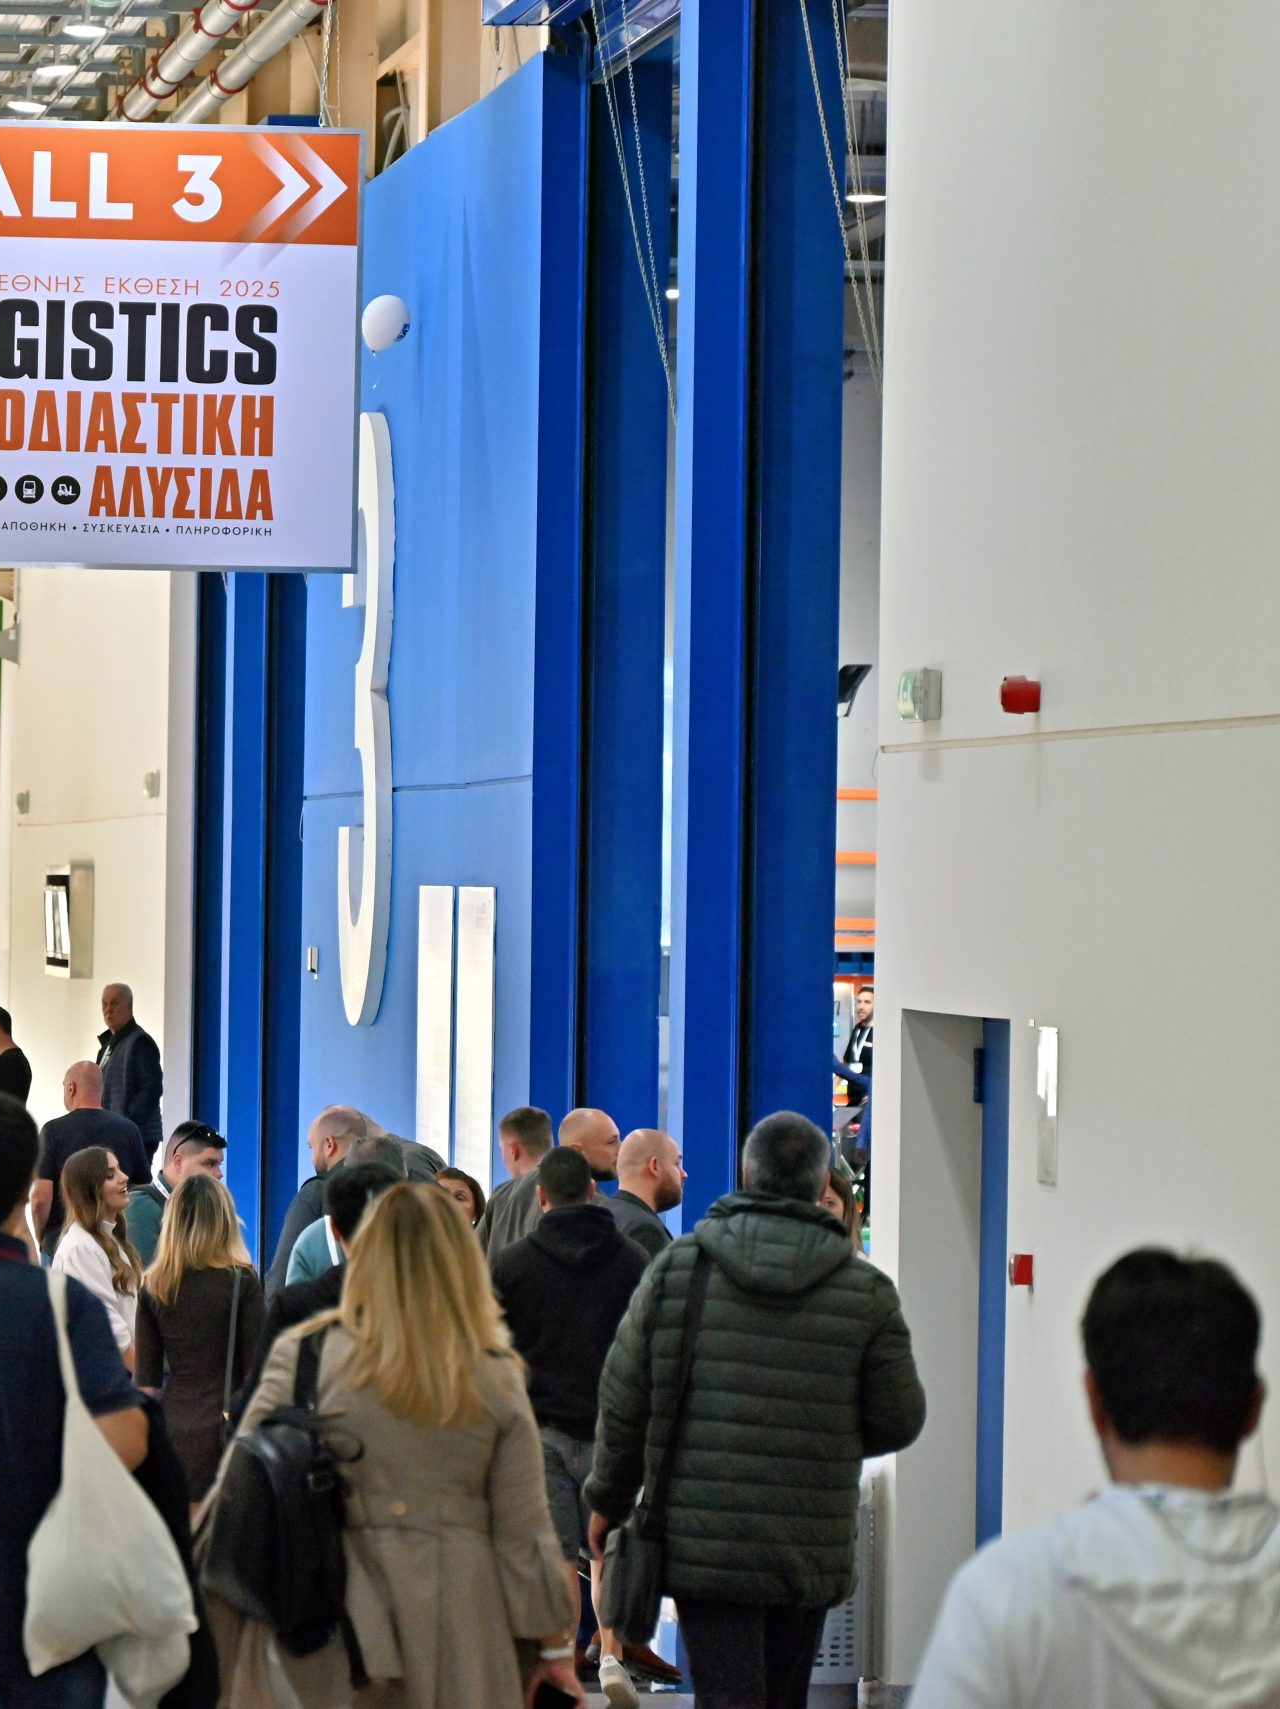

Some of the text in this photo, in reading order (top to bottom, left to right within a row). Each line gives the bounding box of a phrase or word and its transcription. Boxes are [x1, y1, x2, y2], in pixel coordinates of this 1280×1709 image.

[172, 155, 222, 222] 3
[104, 276, 201, 296] ΕΚΘΕΣΗ
[219, 278, 280, 299] 2025
[89, 466, 273, 520] ΑΛΥΣΙΔΑ
[2, 522, 65, 531] ΑΠΟΘΗΚΗ
[84, 524, 159, 533] ΣΥΣΚΕΥΑΣΙΑ
[176, 526, 271, 536] ΠΛΗΡΟΦΟΡΙΚΗ
